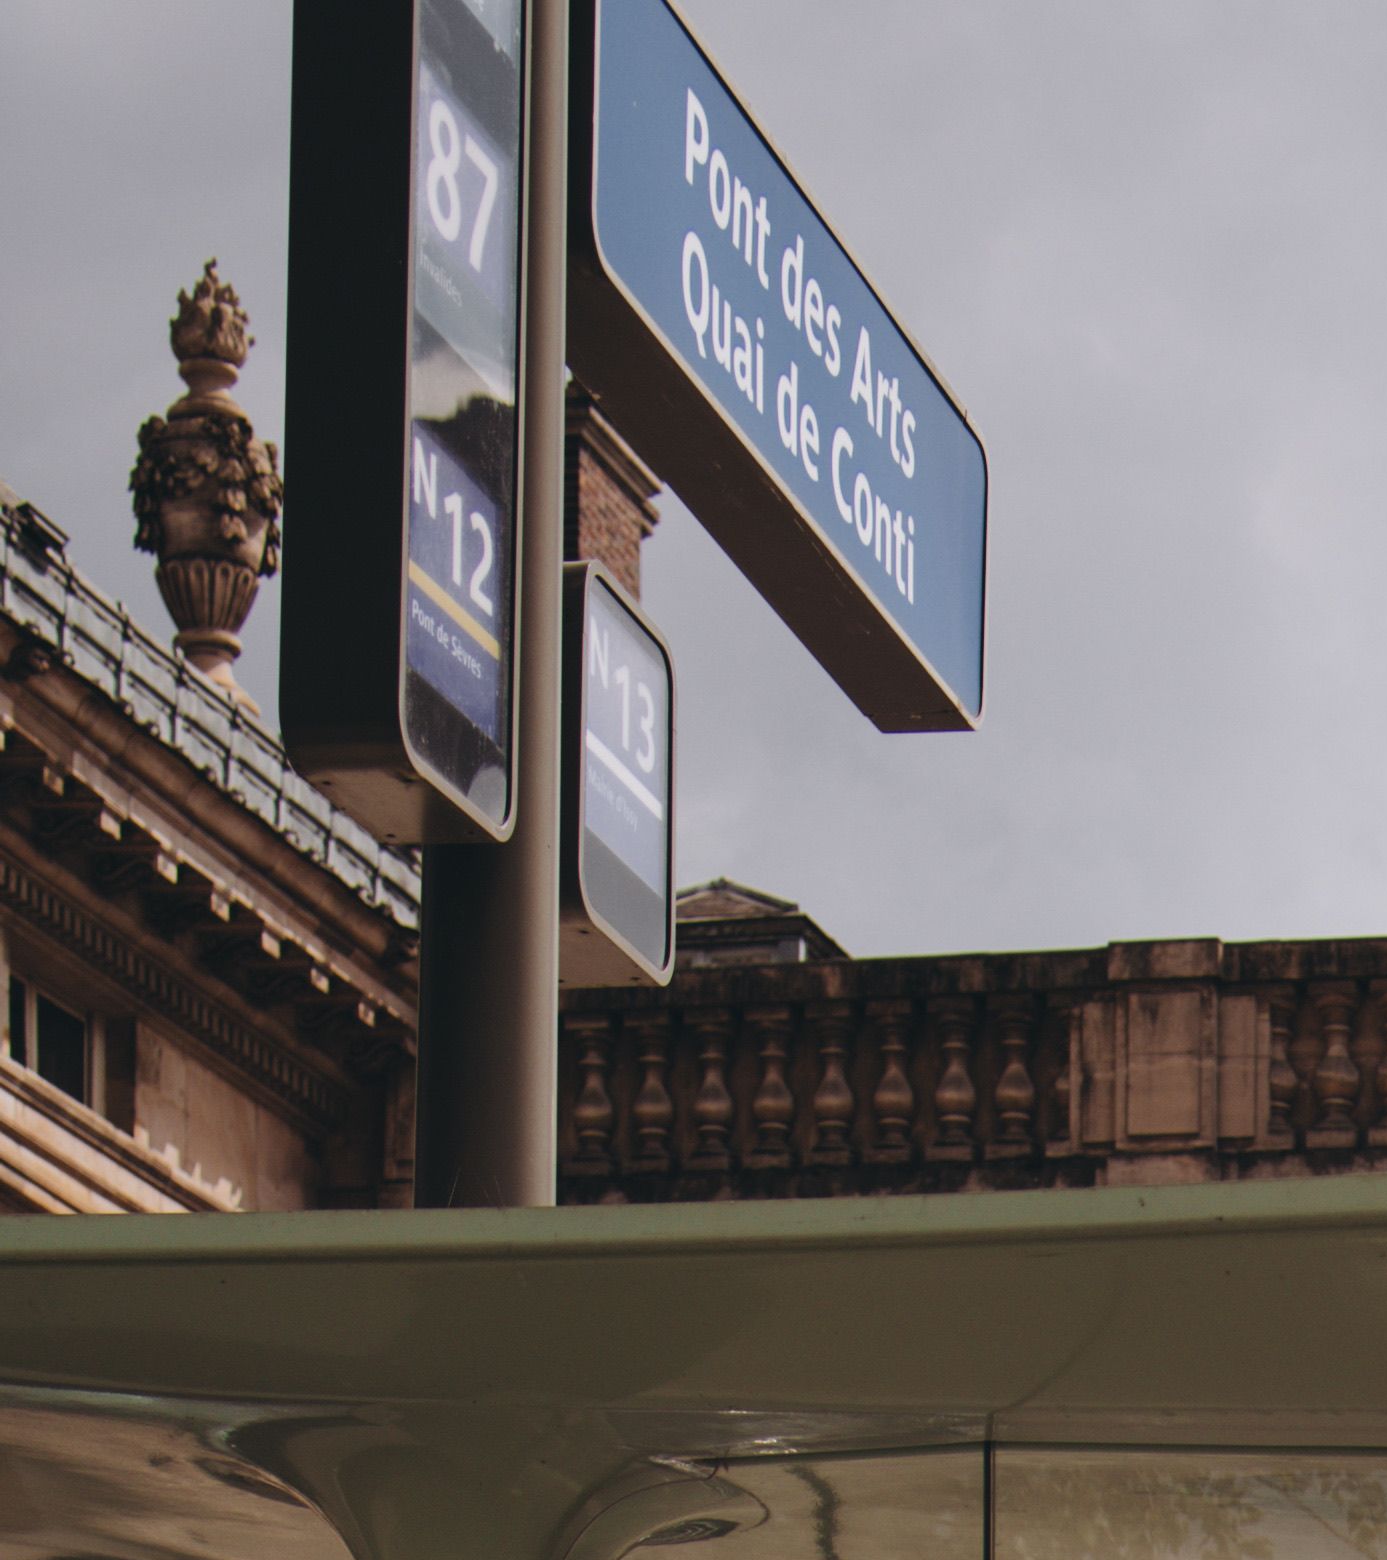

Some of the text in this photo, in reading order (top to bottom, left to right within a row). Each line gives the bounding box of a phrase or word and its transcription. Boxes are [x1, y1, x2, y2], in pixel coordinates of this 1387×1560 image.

[427, 100, 498, 273] 87
[417, 246, 462, 307] Invalides
[685, 86, 916, 479] Pont des Arts
[682, 231, 915, 605] Quai de Conti
[412, 598, 482, 679] Pont de Sèvres
